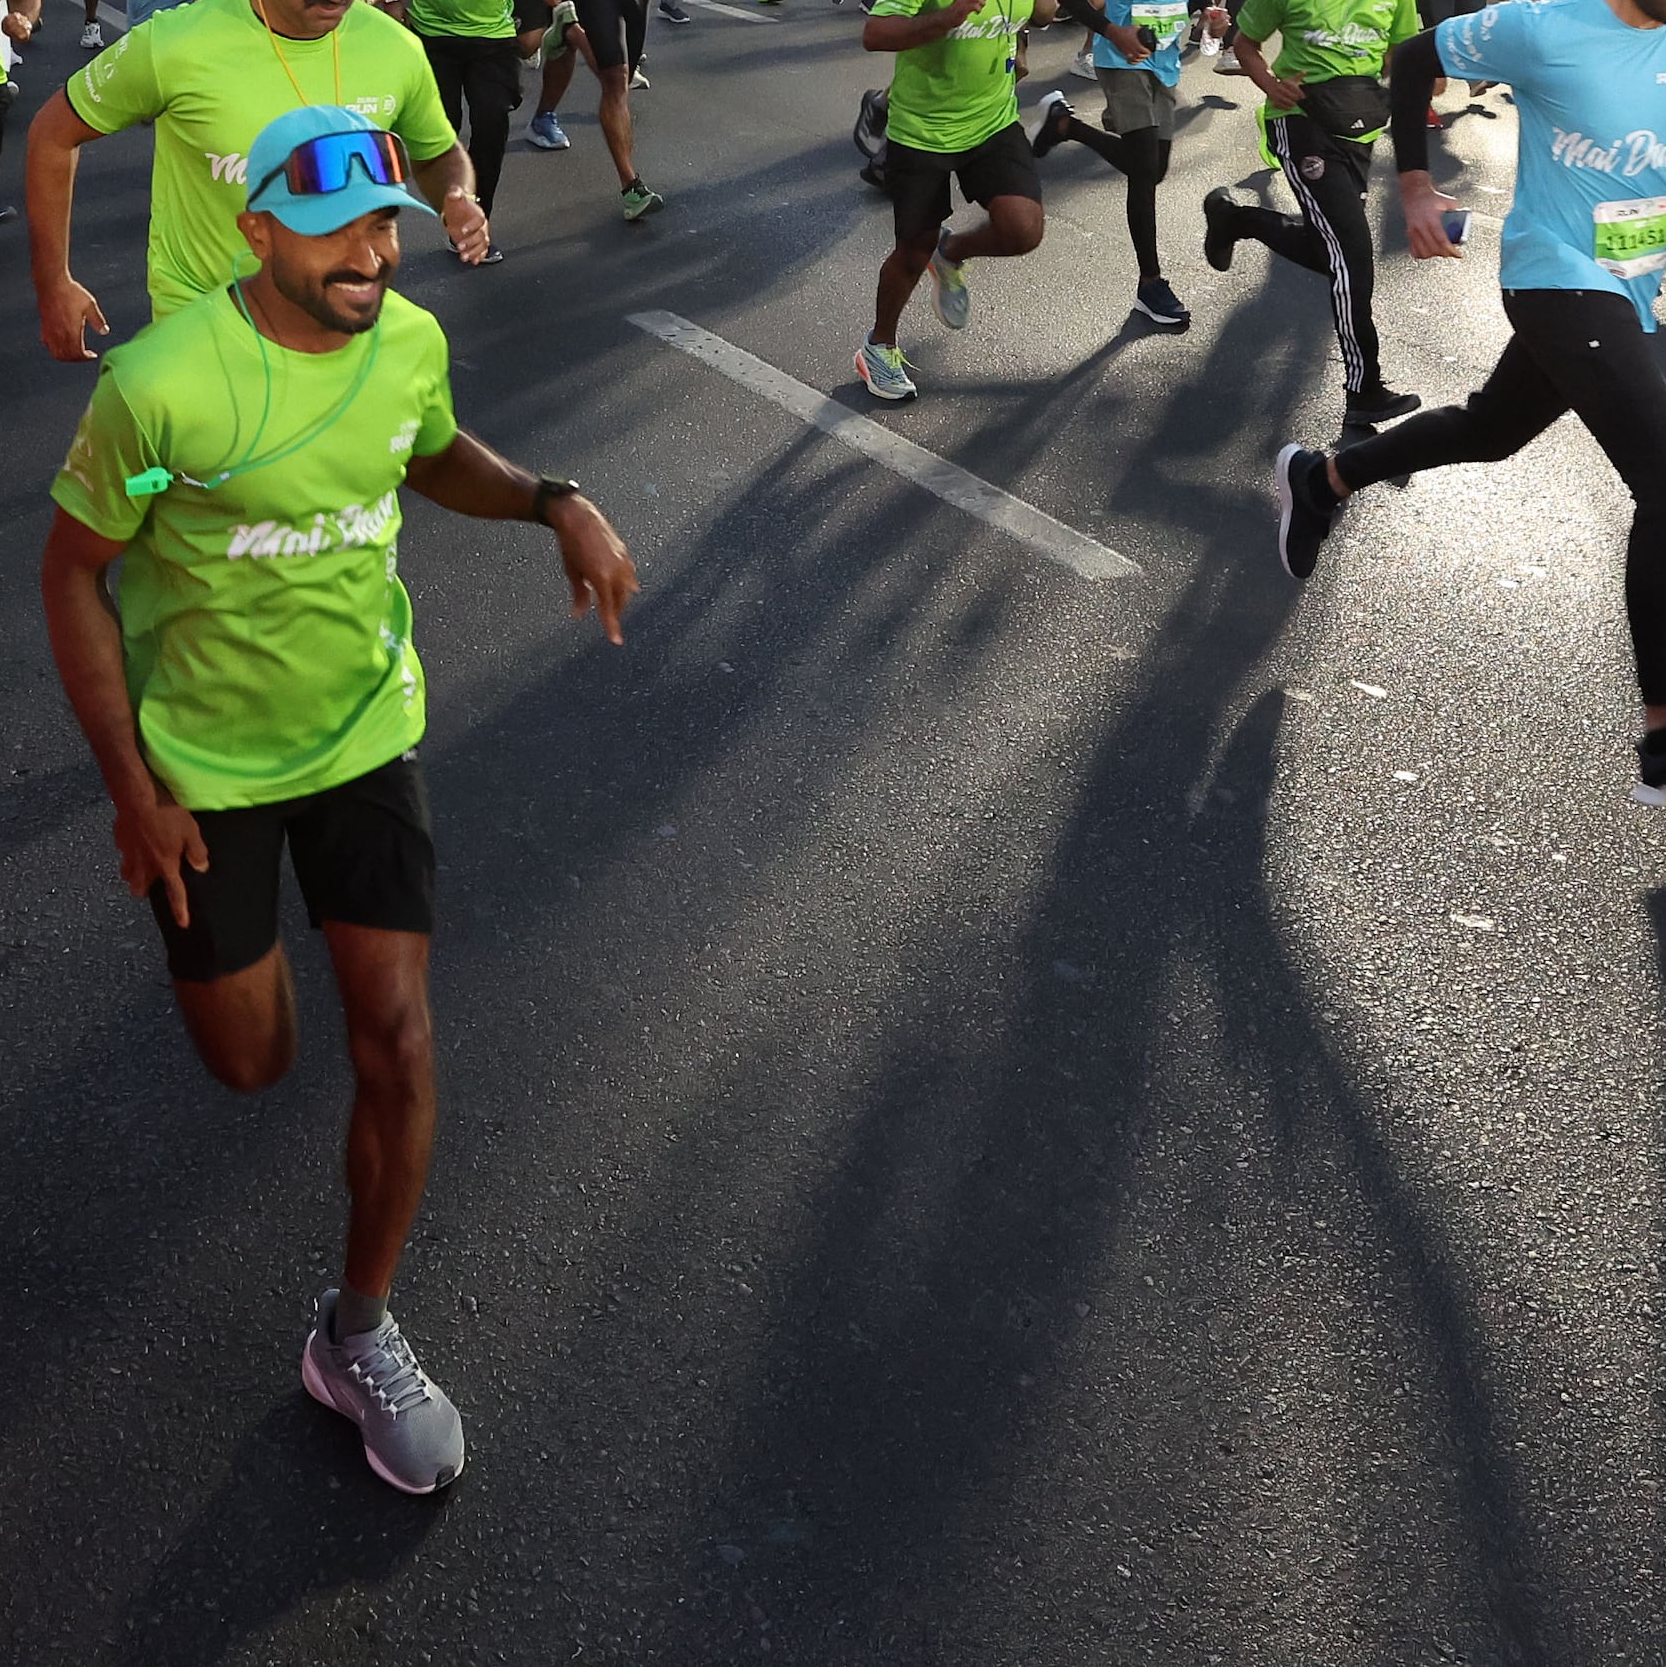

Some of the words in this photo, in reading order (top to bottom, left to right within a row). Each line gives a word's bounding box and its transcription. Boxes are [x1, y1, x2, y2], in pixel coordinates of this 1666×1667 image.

[345, 102, 378, 114] RUN
[1551, 127, 1623, 172] Mai
[1606, 229, 1666, 251] 111451
